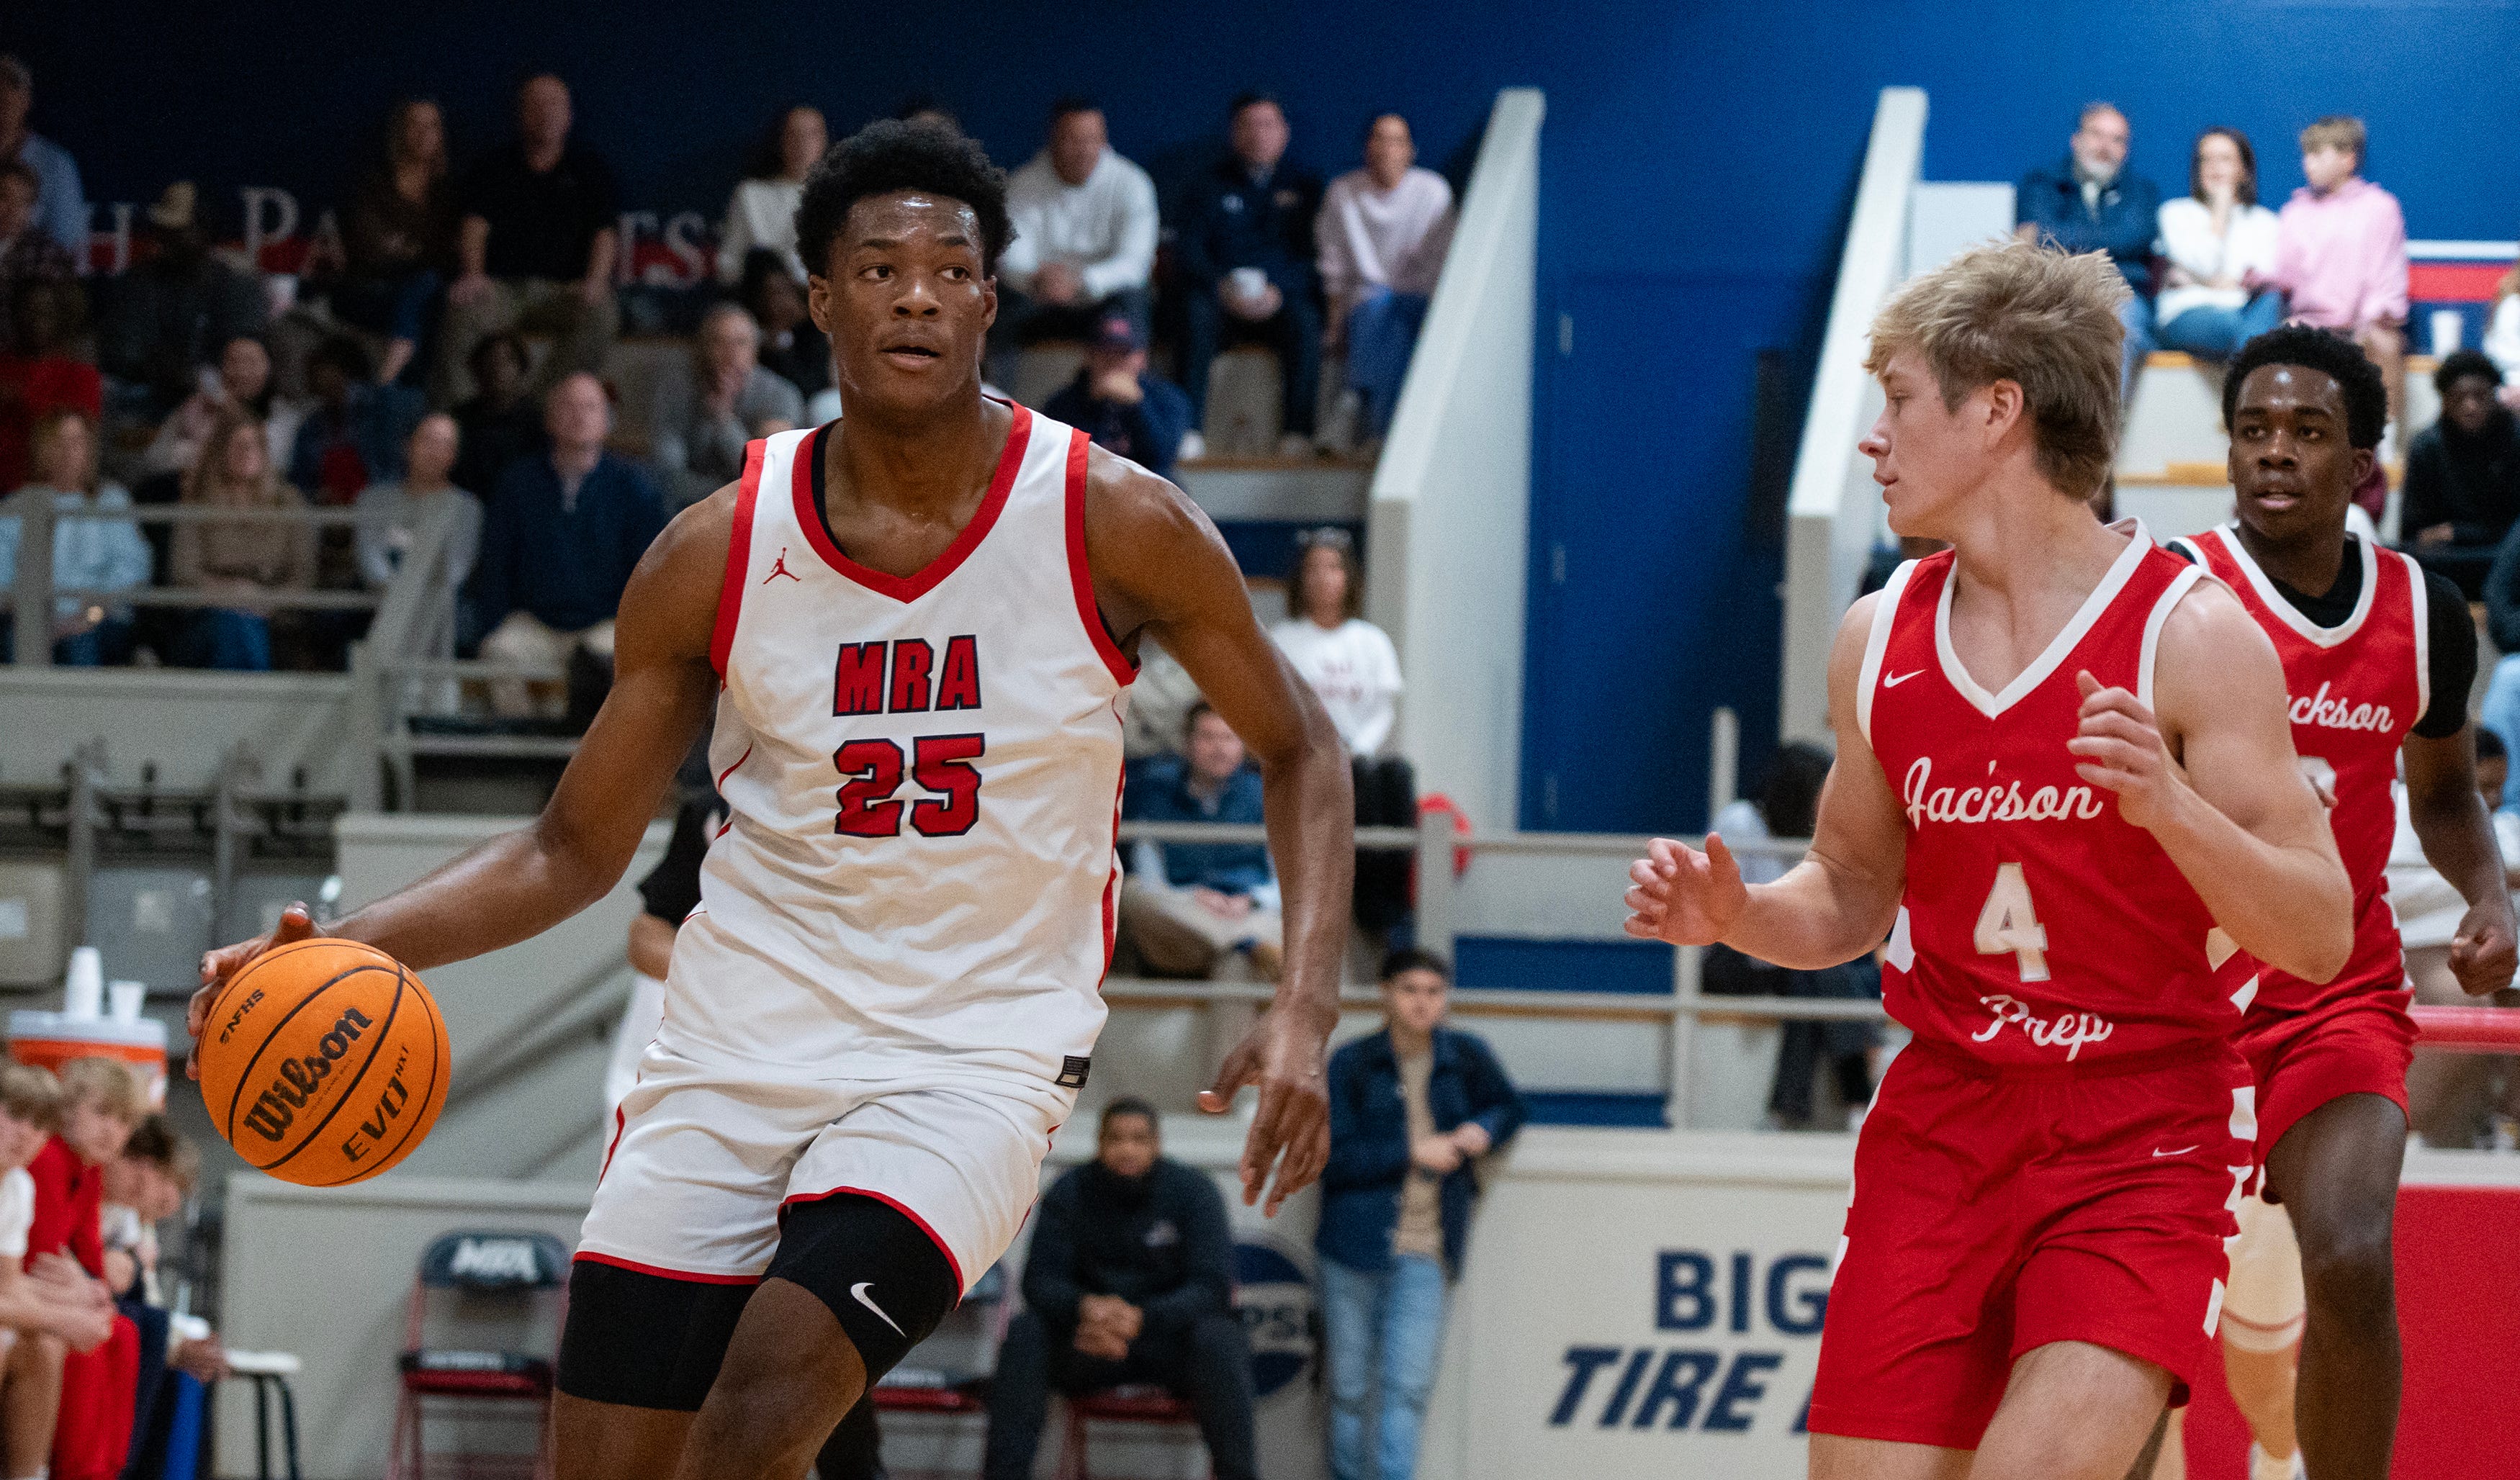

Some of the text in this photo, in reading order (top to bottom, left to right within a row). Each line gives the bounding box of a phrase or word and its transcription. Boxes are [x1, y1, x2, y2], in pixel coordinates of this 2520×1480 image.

[832, 634, 982, 717] MRA
[2287, 680, 2395, 734] ckson
[832, 732, 986, 838] 25
[1904, 757, 2103, 832] Jackson
[1974, 862, 2051, 983] 4
[225, 988, 265, 1034] NFHS
[1971, 994, 2114, 1062] Prep
[243, 1007, 373, 1142] Wilson
[341, 1076, 409, 1163] EVO
[1655, 1249, 1832, 1337] BIG
[1549, 1343, 1783, 1432] TIRE
